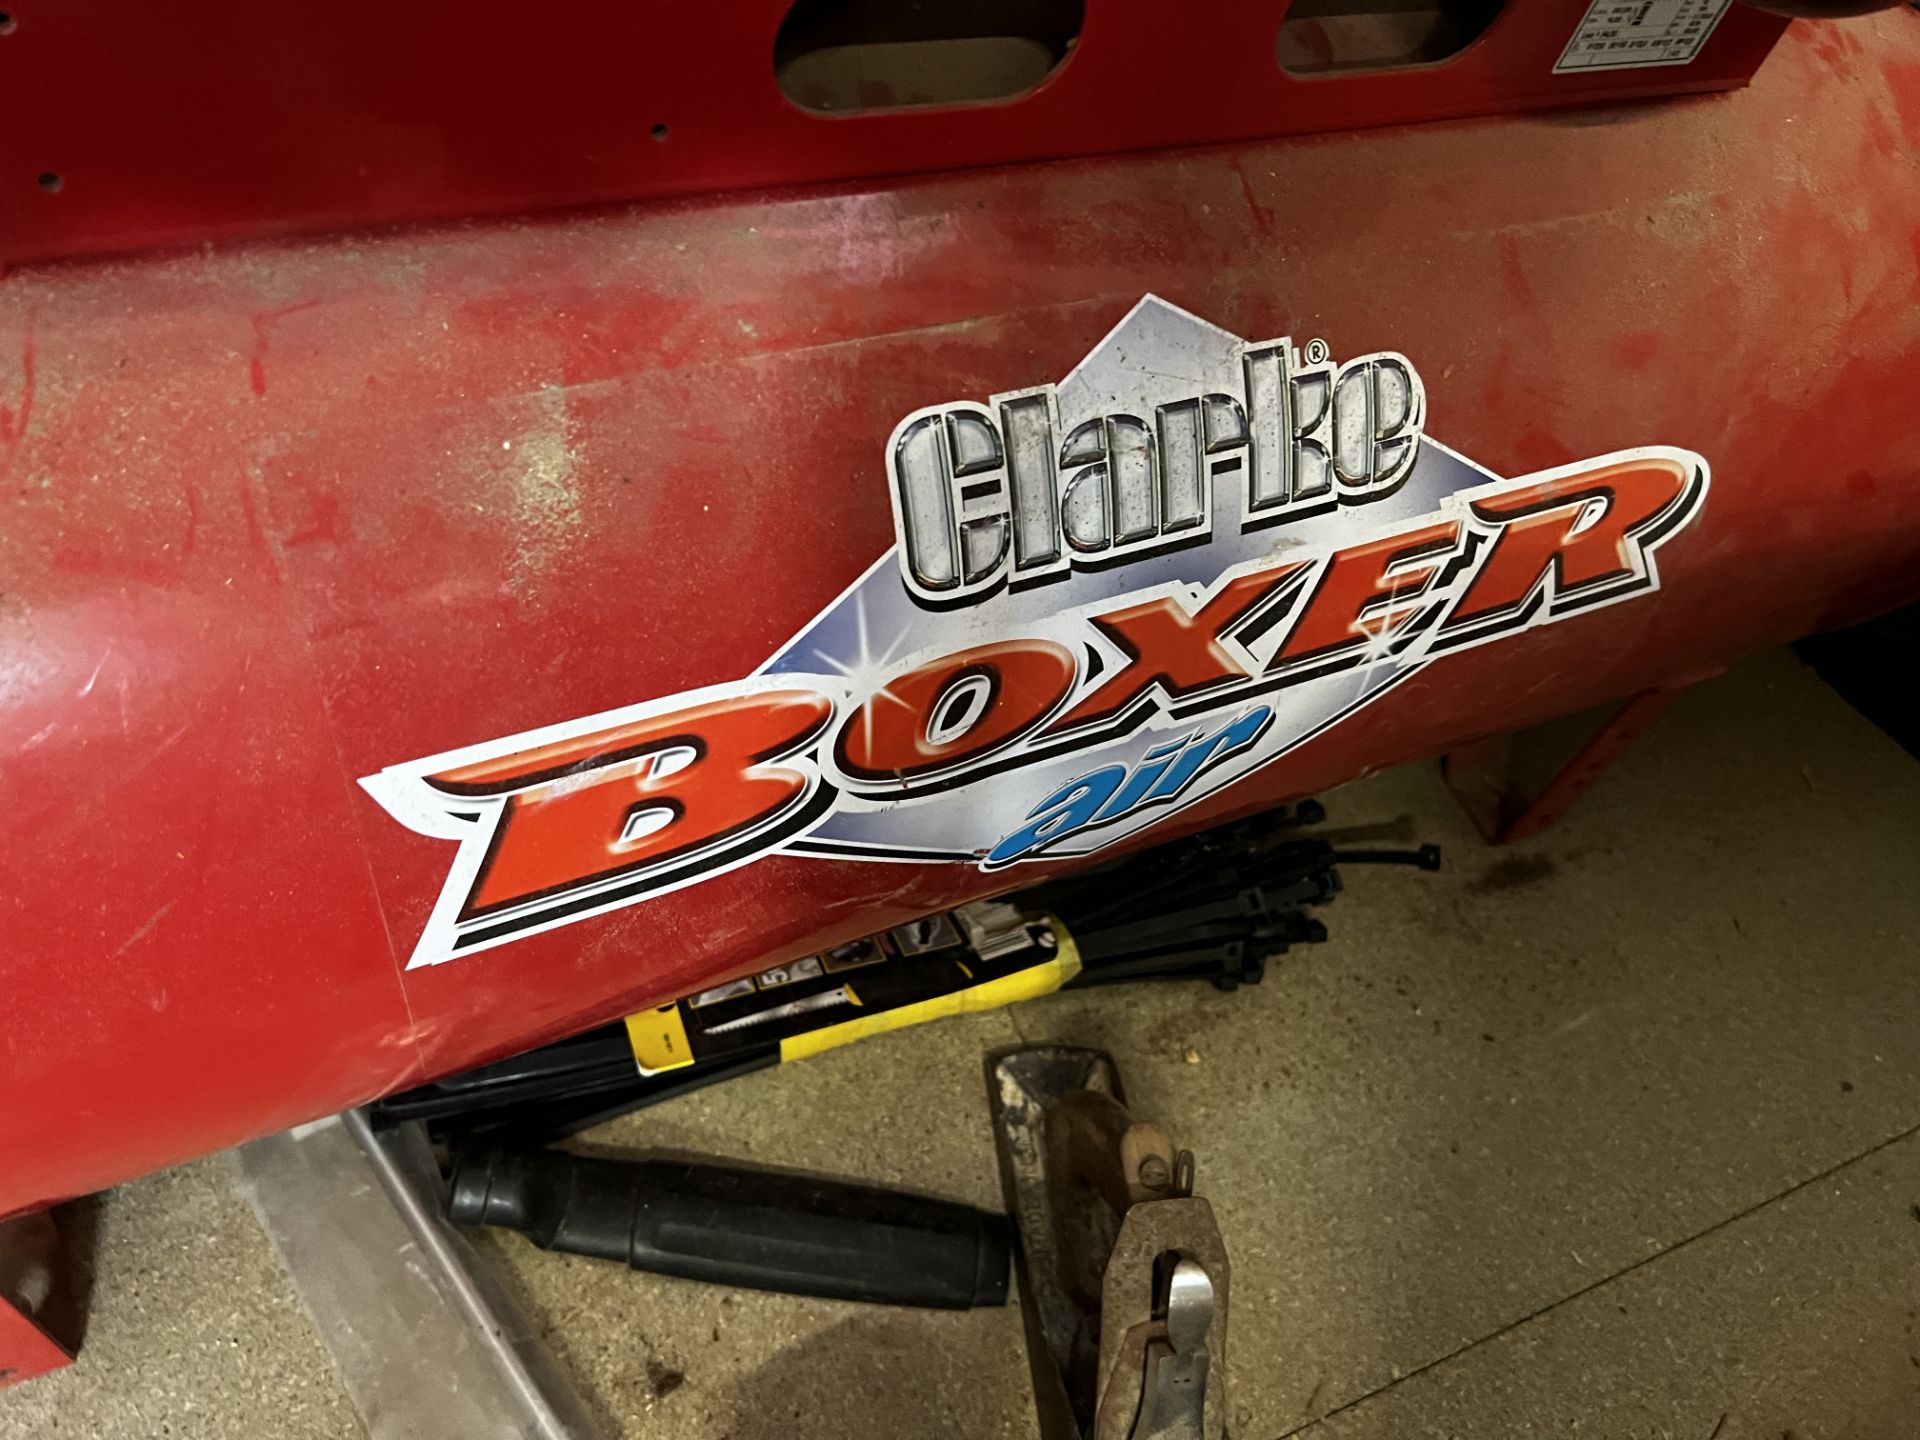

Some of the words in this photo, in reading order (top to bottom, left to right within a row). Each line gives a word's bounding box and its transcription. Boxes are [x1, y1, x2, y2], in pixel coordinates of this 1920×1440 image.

[892, 341, 1418, 594] Clarke
[422, 457, 1690, 930] BOXER
[986, 704, 1273, 863] air
